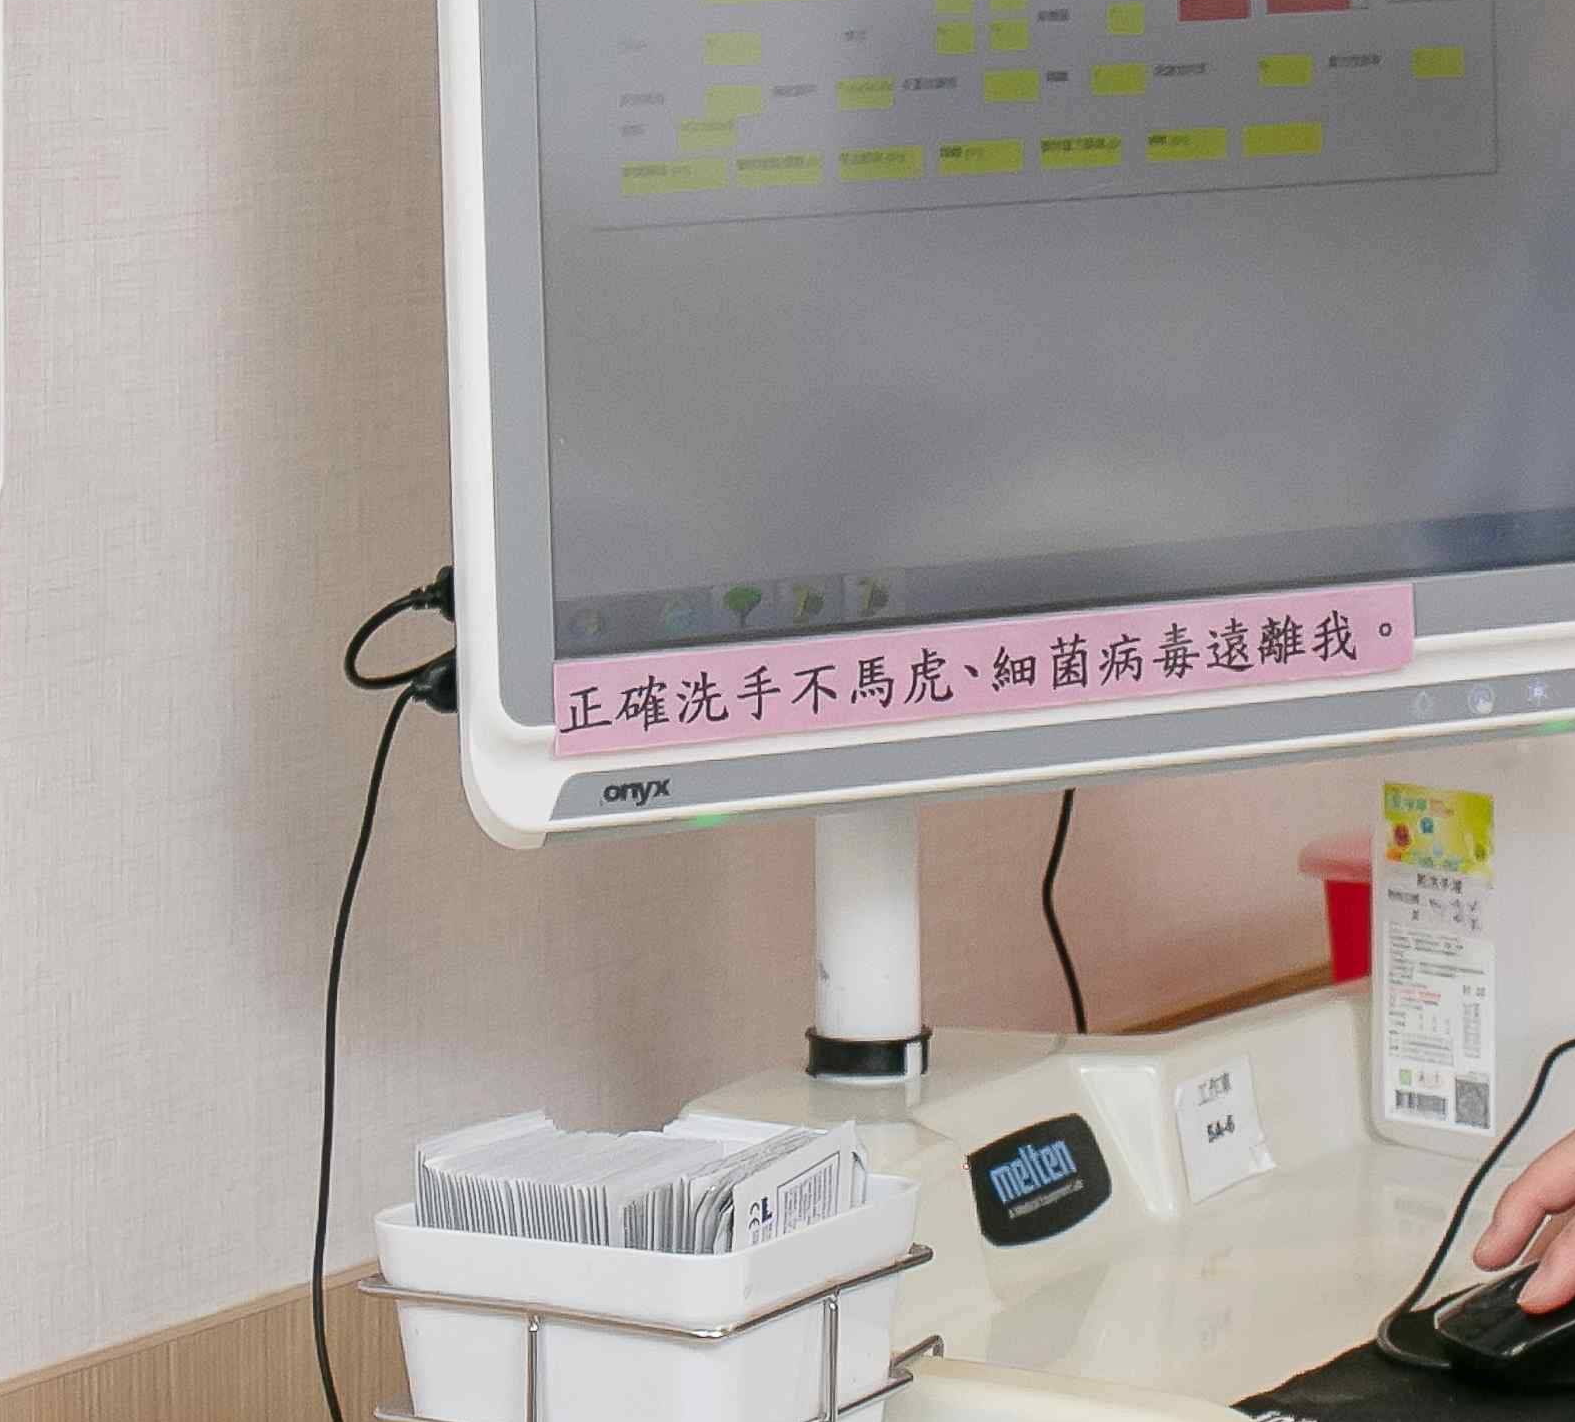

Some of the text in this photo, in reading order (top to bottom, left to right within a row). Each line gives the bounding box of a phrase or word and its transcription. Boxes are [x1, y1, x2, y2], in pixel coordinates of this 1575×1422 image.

[559, 608, 1396, 737] 正確洗手不馬虎、細菌病毒遠離我。
[603, 778, 671, 807] onyx
